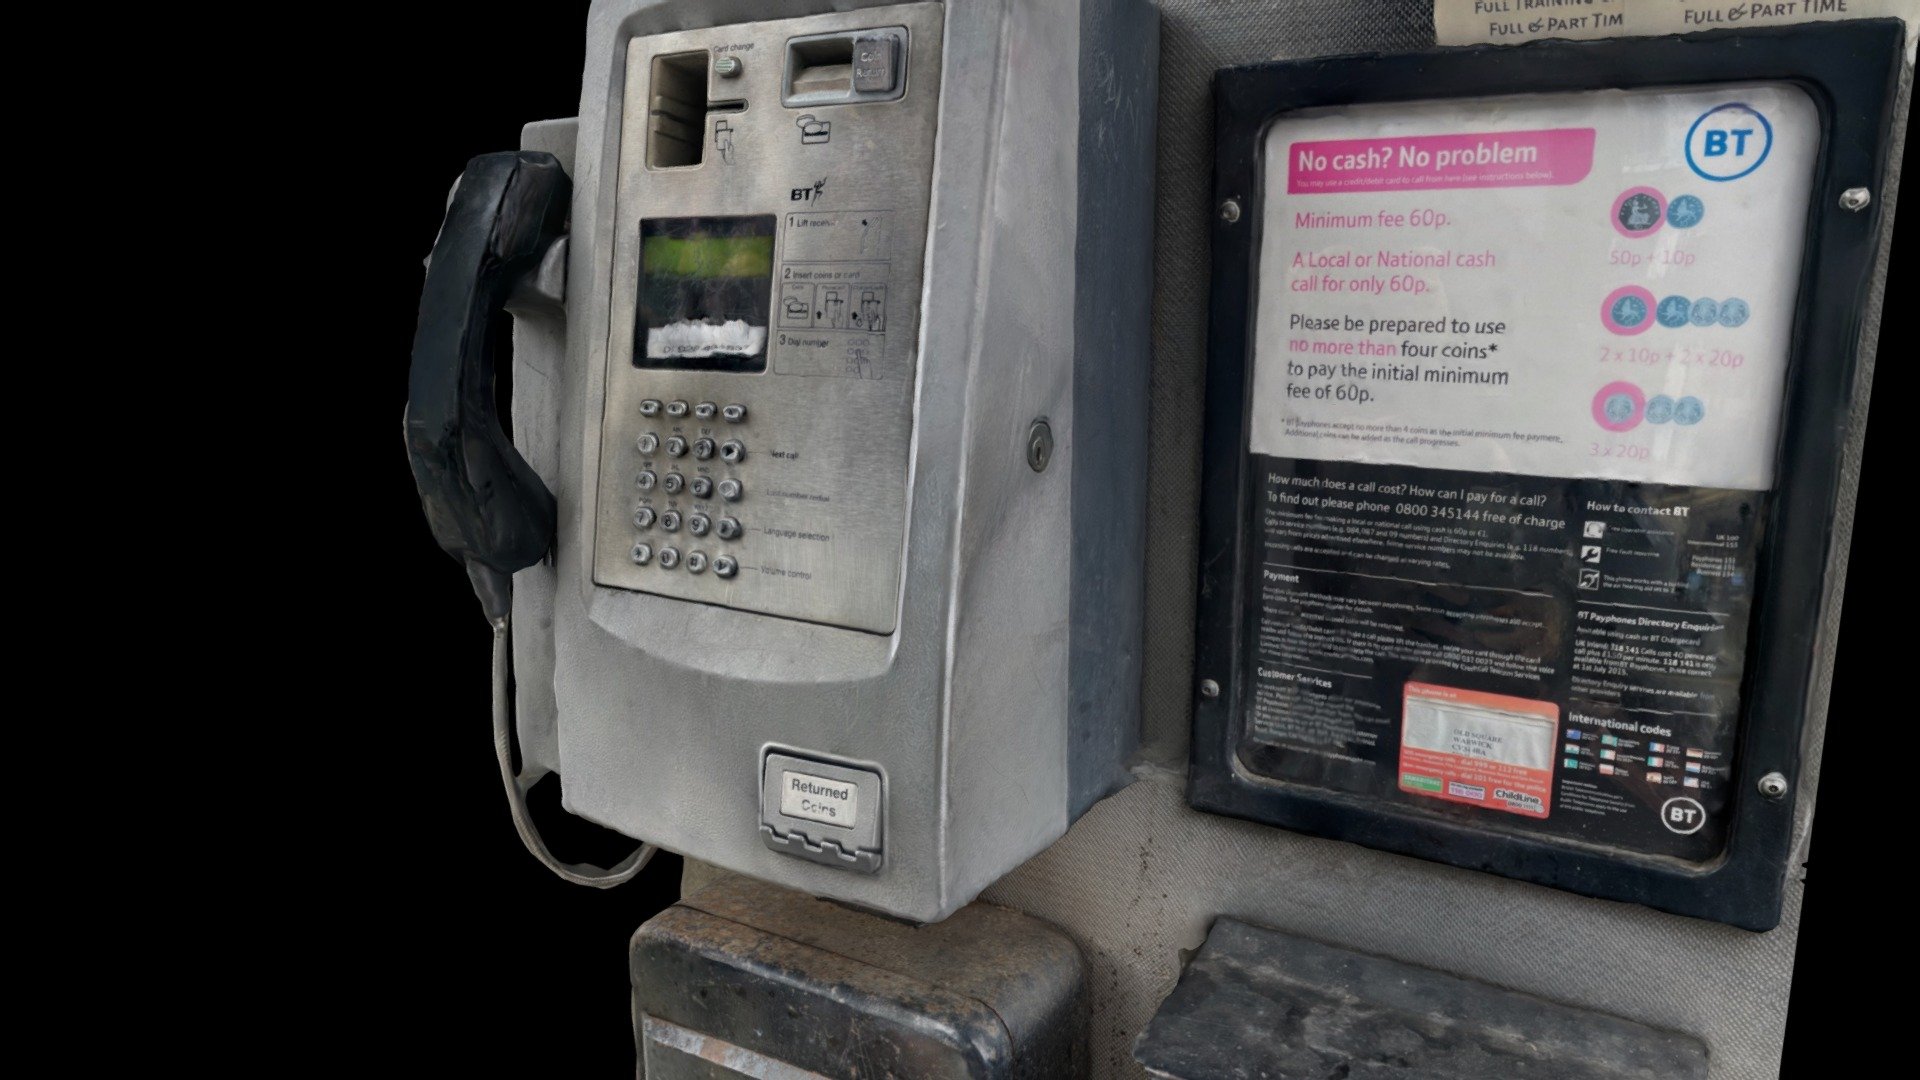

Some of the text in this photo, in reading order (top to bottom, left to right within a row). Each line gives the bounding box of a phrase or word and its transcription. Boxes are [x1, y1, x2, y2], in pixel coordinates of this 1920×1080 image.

[1475, 1, 1509, 14] FULL
[1685, 0, 1847, 24] FULL & PART TIME
[1490, 13, 1623, 35] FULL & PART TIM
[714, 43, 754, 52] Card change
[1704, 129, 1753, 157] BT
[1299, 143, 1537, 173] No cash? No problem
[791, 188, 813, 201] BT
[789, 217, 794, 227] 1
[797, 219, 808, 227] Lift
[1295, 209, 1450, 229] Minimum fee 60p.
[1292, 250, 1495, 268] A Local or National cash
[1610, 250, 1641, 267] 50p
[1663, 250, 1695, 267] 10p
[785, 268, 791, 279] 2
[793, 271, 811, 279] Insert
[1291, 275, 1430, 295] call for only 60p.
[1290, 314, 1506, 335] Please be prepared to use
[780, 334, 828, 348] 3 Dial number
[1290, 340, 1309, 352] no
[1312, 342, 1353, 355] more
[1357, 340, 1396, 356] than
[1401, 341, 1438, 358] four
[1600, 348, 1610, 363] 2
[1614, 351, 1626, 361] x
[1629, 349, 1660, 365] 10p
[1681, 349, 1689, 364] 2
[1692, 352, 1704, 364] x
[1709, 351, 1744, 368] 20p
[1287, 361, 1509, 385] to pay the initial minimum
[1286, 383, 1374, 403] fee of 60p.
[1410, 427, 1428, 435] coins
[1439, 428, 1452, 436] the
[1453, 429, 1473, 437] initial
[1475, 430, 1511, 439] minimum
[1588, 443, 1649, 460] 3 x 20p
[1268, 473, 1547, 507] How much does a call cost? How can I pay for a call?
[1267, 491, 1566, 530] To find out please phone 0800 345144 free of charge
[1587, 501, 1690, 517] How to contact BT
[764, 527, 830, 541] Language selection
[761, 565, 812, 580] Volume control
[1264, 570, 1299, 583] Payment
[1577, 611, 1589, 620] BT
[1590, 611, 1637, 625] Payphones
[1638, 617, 1680, 631] Directory
[1607, 630, 1624, 639] using
[1625, 632, 1641, 640] cash
[1661, 636, 1701, 646] Chargecard
[1258, 667, 1332, 688] Customer Services
[1568, 712, 1672, 737] International codes
[1453, 737, 1494, 749] WARWICK
[1472, 732, 1503, 743] SQUARE
[792, 778, 848, 800] Returned
[1495, 790, 1539, 804] ChildLine
[1671, 807, 1696, 824] BT
